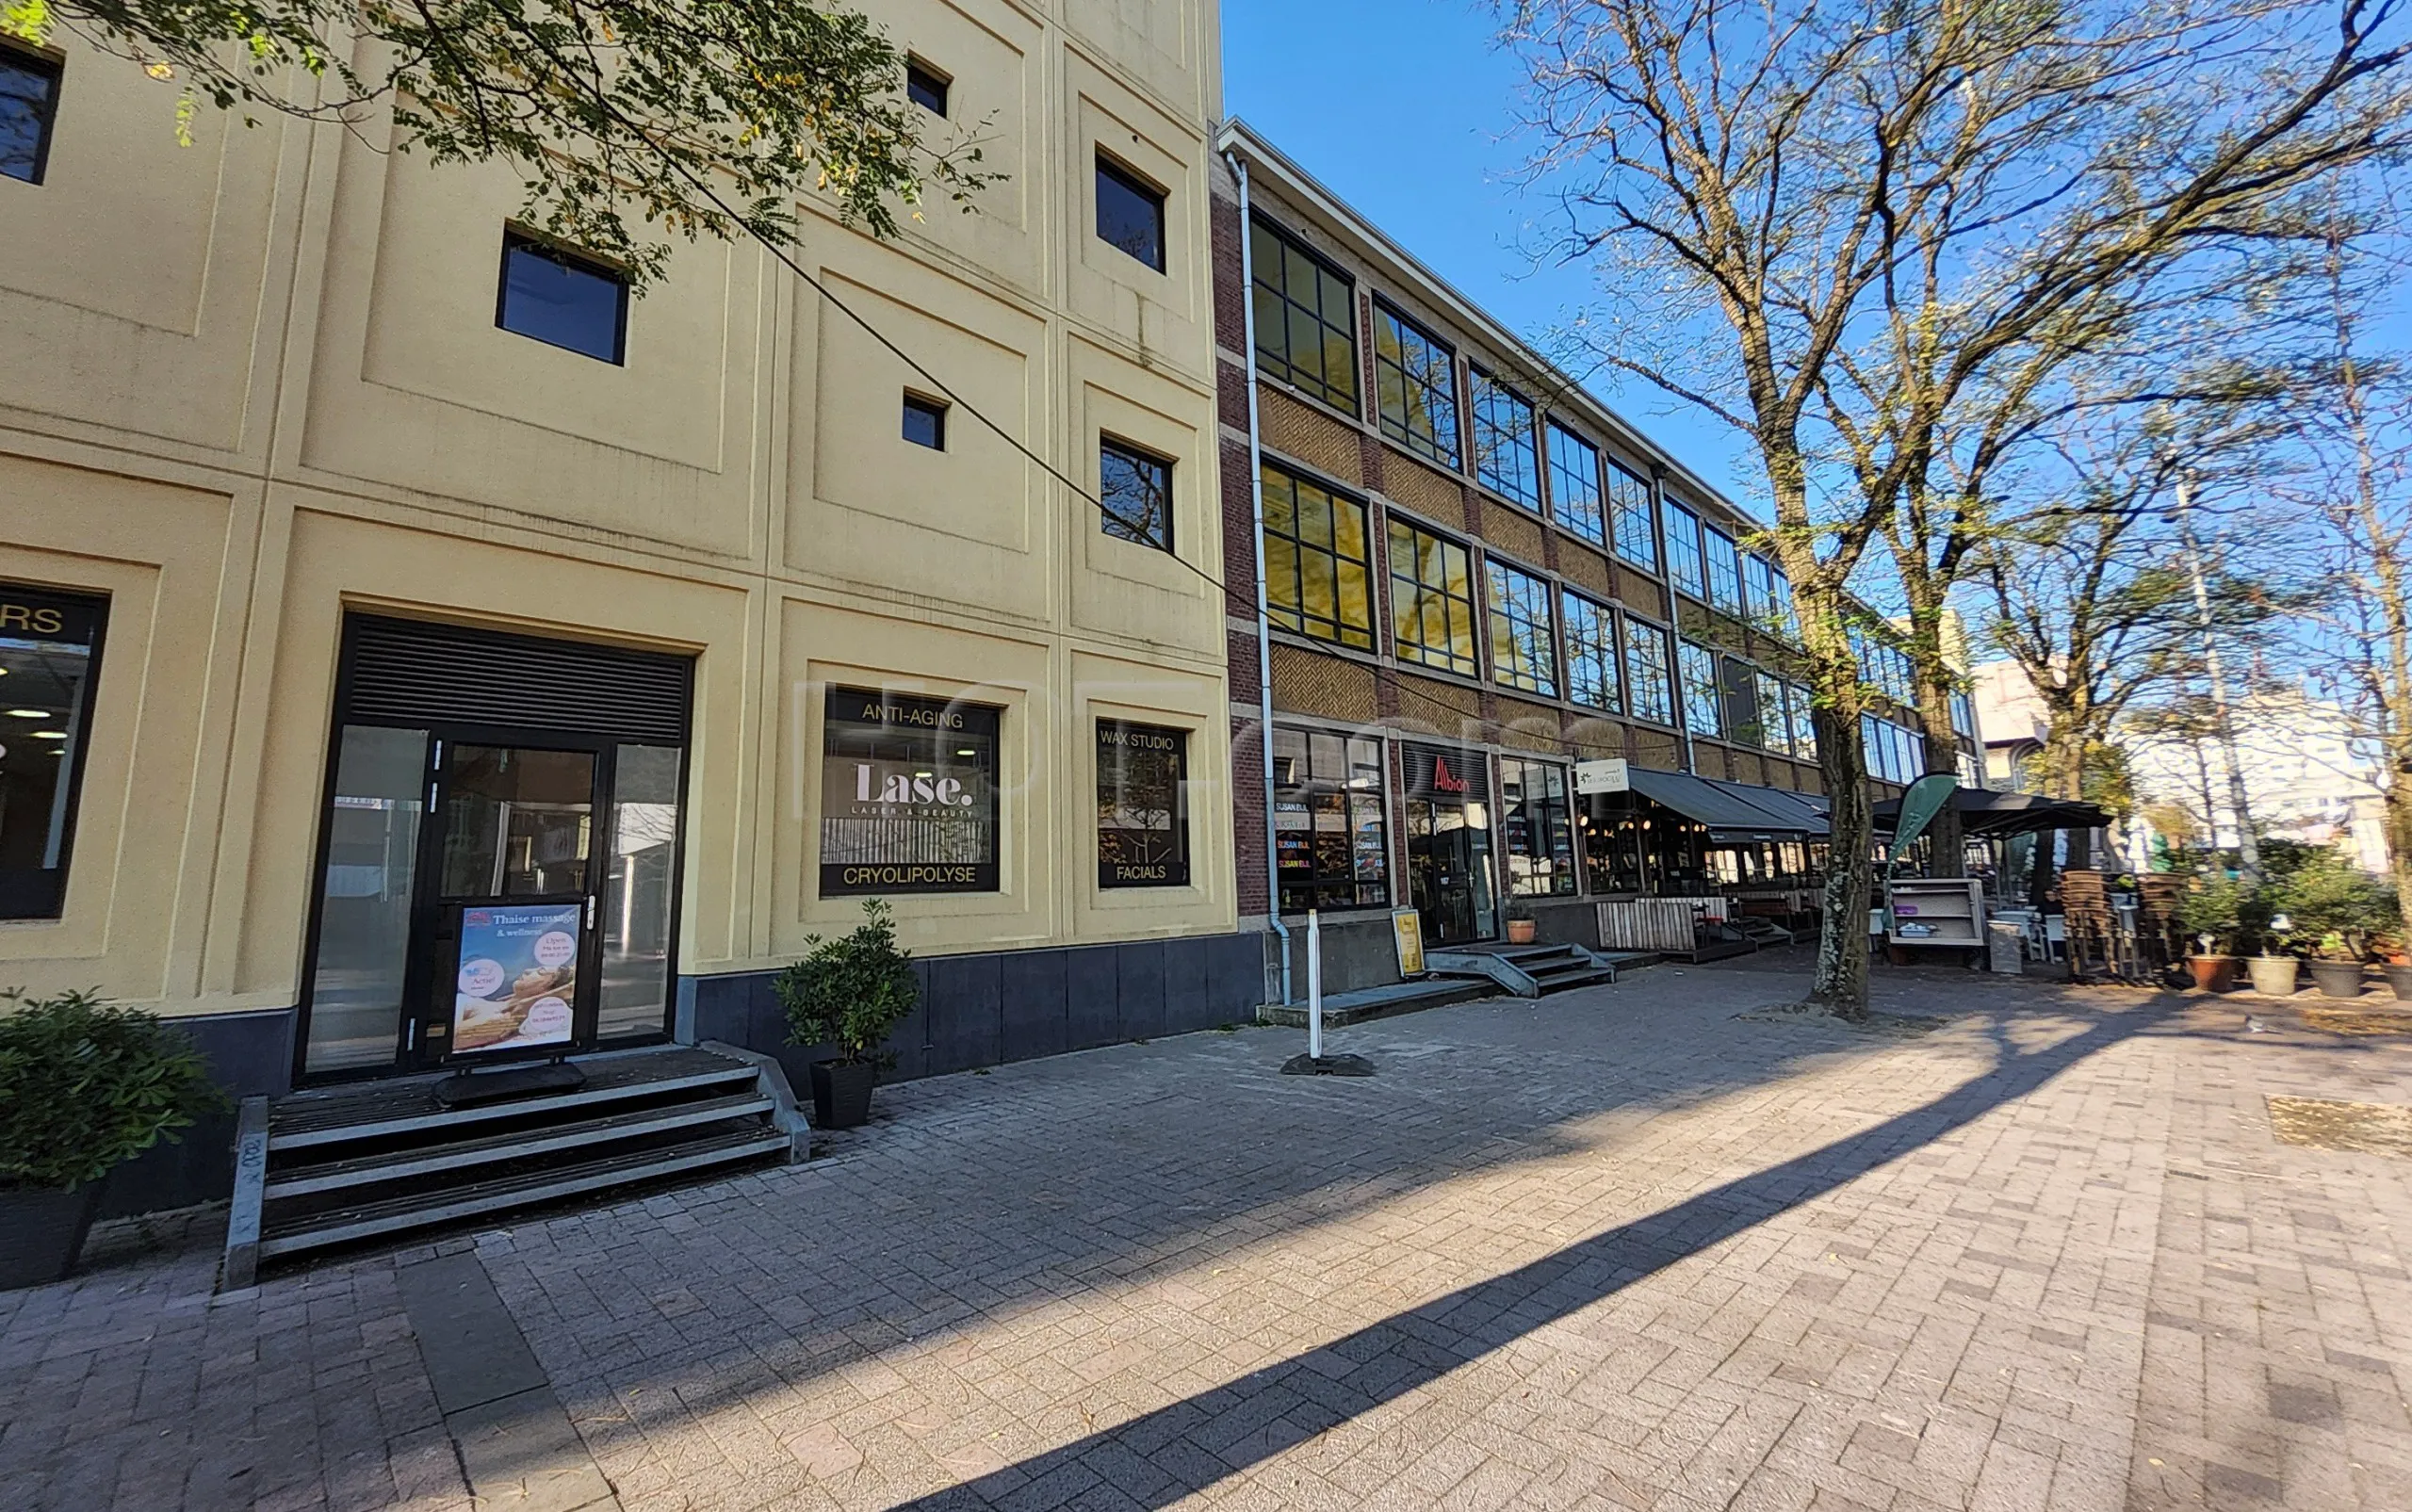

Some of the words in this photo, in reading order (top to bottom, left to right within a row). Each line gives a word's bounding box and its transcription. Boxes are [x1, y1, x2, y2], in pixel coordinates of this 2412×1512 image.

[0, 604, 63, 633] RS
[861, 704, 964, 728] ANTI-AGING
[1100, 730, 1129, 745] WAX
[1131, 734, 1174, 750] STUDIO
[1434, 755, 1470, 792] Albion
[853, 763, 973, 805] Lase.
[851, 806, 896, 815] LASER
[923, 807, 973, 818] BEAUTY
[1276, 803, 1296, 811] SUSAN
[1277, 840, 1297, 849] SUSAN
[843, 867, 976, 884] CRYOLIPOLYSE
[1116, 865, 1166, 880] FACIALS
[493, 915, 530, 925] Thaise
[531, 914, 576, 924] massage
[497, 929, 505, 937] &
